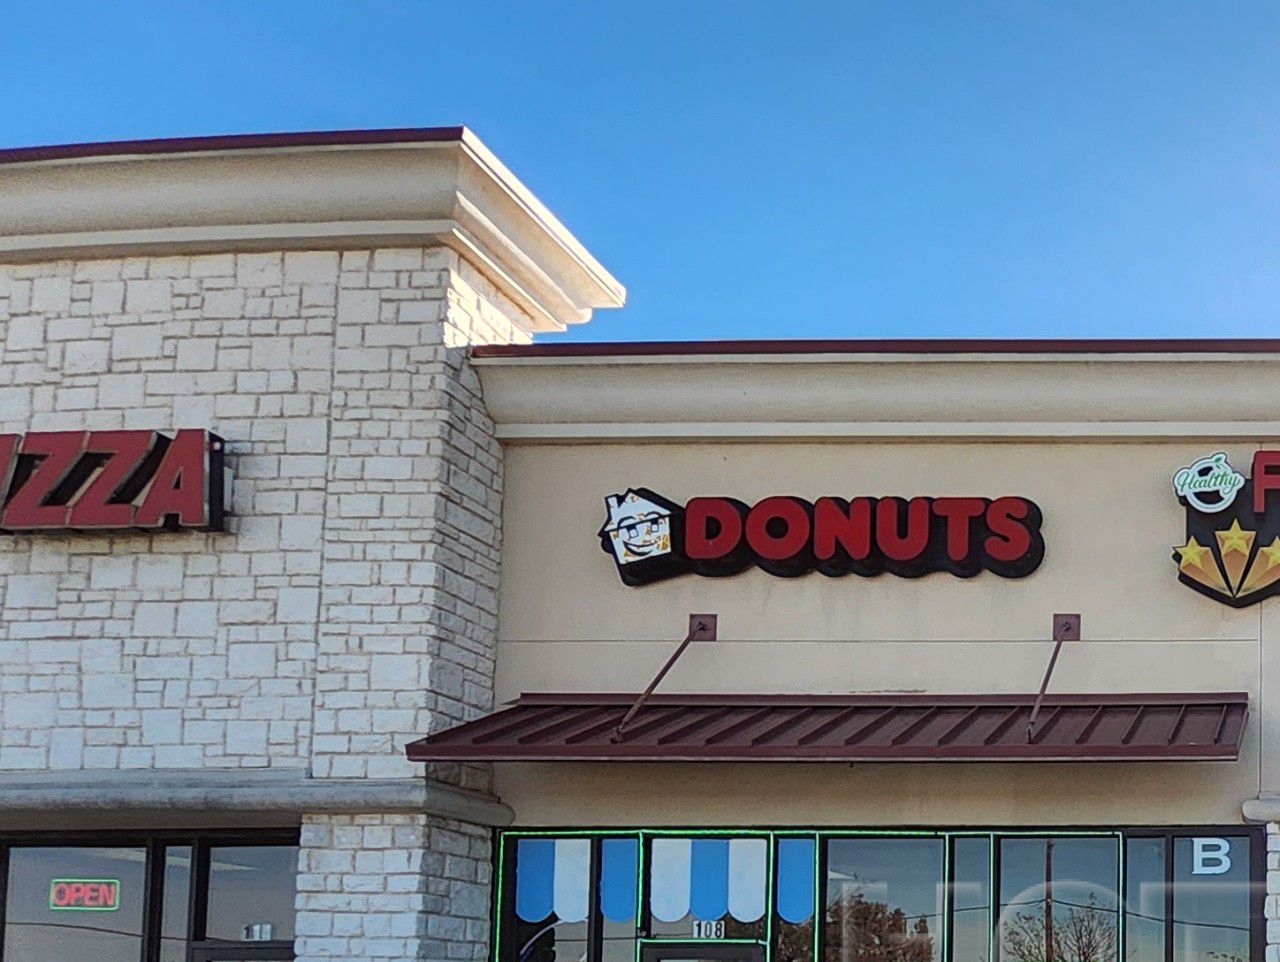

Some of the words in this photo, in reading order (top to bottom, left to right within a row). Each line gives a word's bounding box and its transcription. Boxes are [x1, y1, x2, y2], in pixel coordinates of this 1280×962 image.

[1177, 470, 1241, 495] Healthy
[685, 496, 1030, 561] DONUTS
[1192, 838, 1231, 875] B
[53, 882, 116, 907] OPEN
[694, 921, 725, 939] 108
